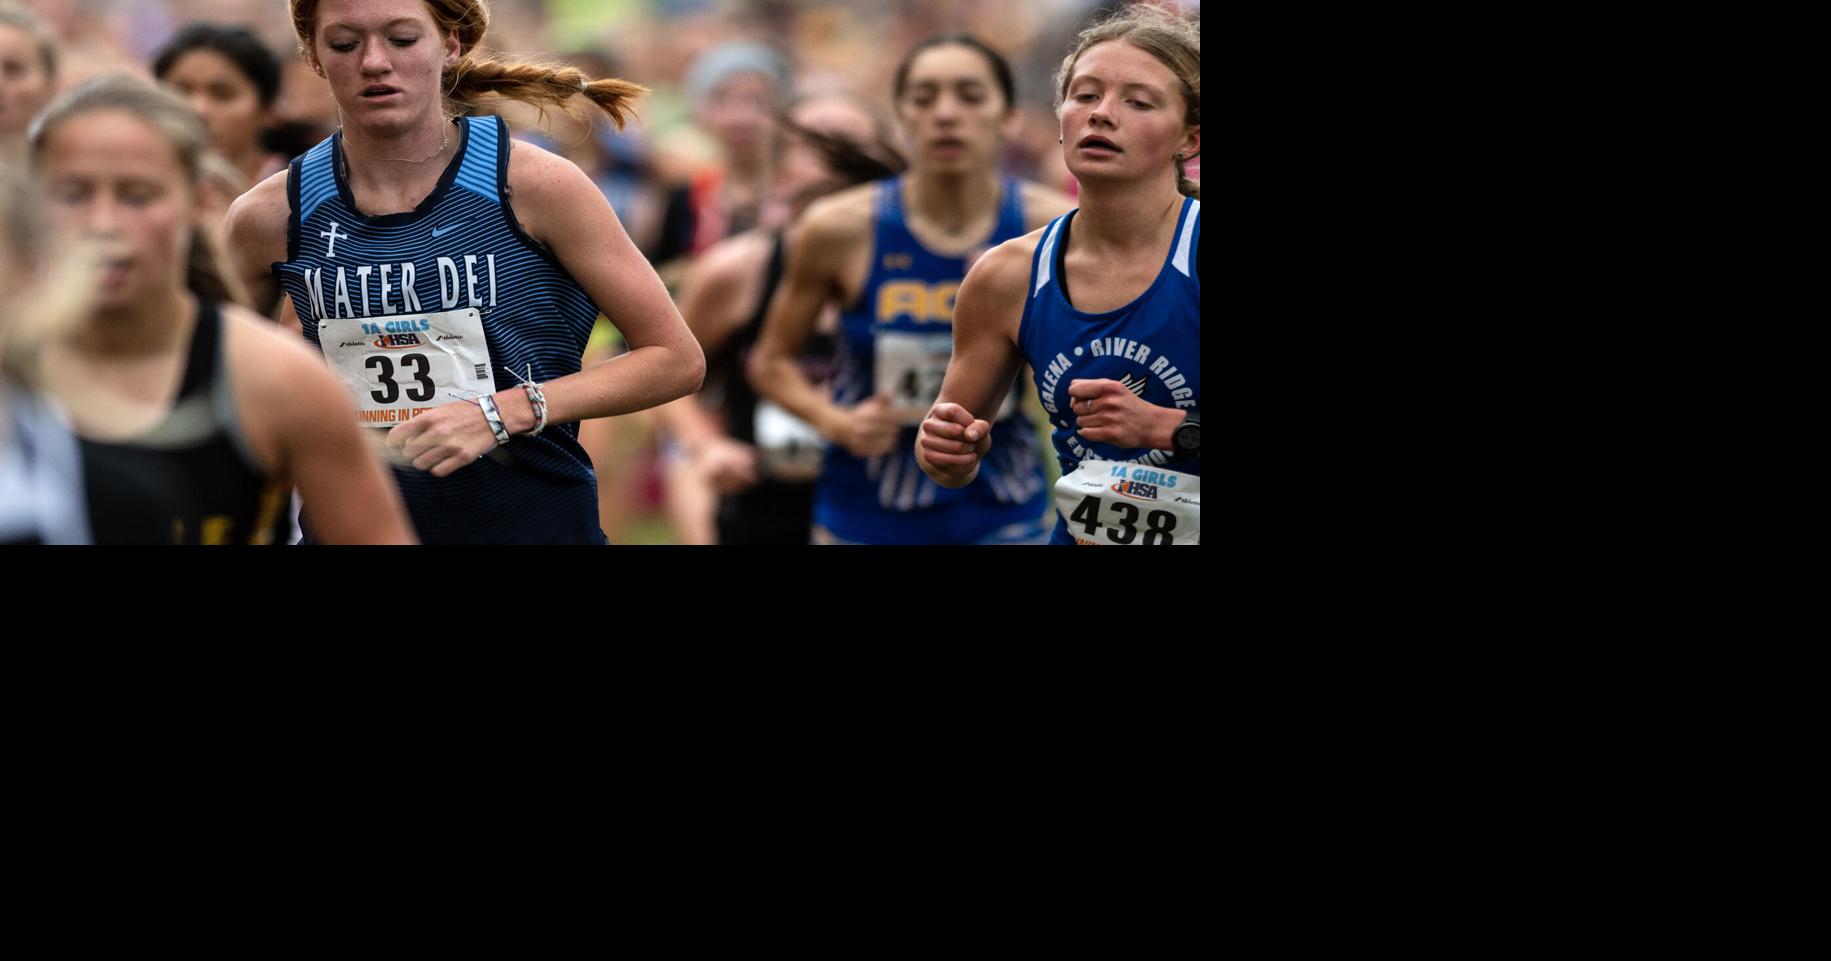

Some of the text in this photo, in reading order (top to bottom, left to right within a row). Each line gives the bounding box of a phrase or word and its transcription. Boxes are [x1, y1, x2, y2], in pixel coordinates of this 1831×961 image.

[304, 253, 497, 320] MATER DEI
[361, 319, 430, 334] 1A GIRLS
[365, 353, 436, 404] 33
[1041, 352, 1073, 414] GALENA
[1090, 337, 1196, 409] RIVER RIDGE
[398, 408, 410, 421] IN
[1110, 465, 1178, 488] 1A GIRLS
[1070, 495, 1177, 546] 438
